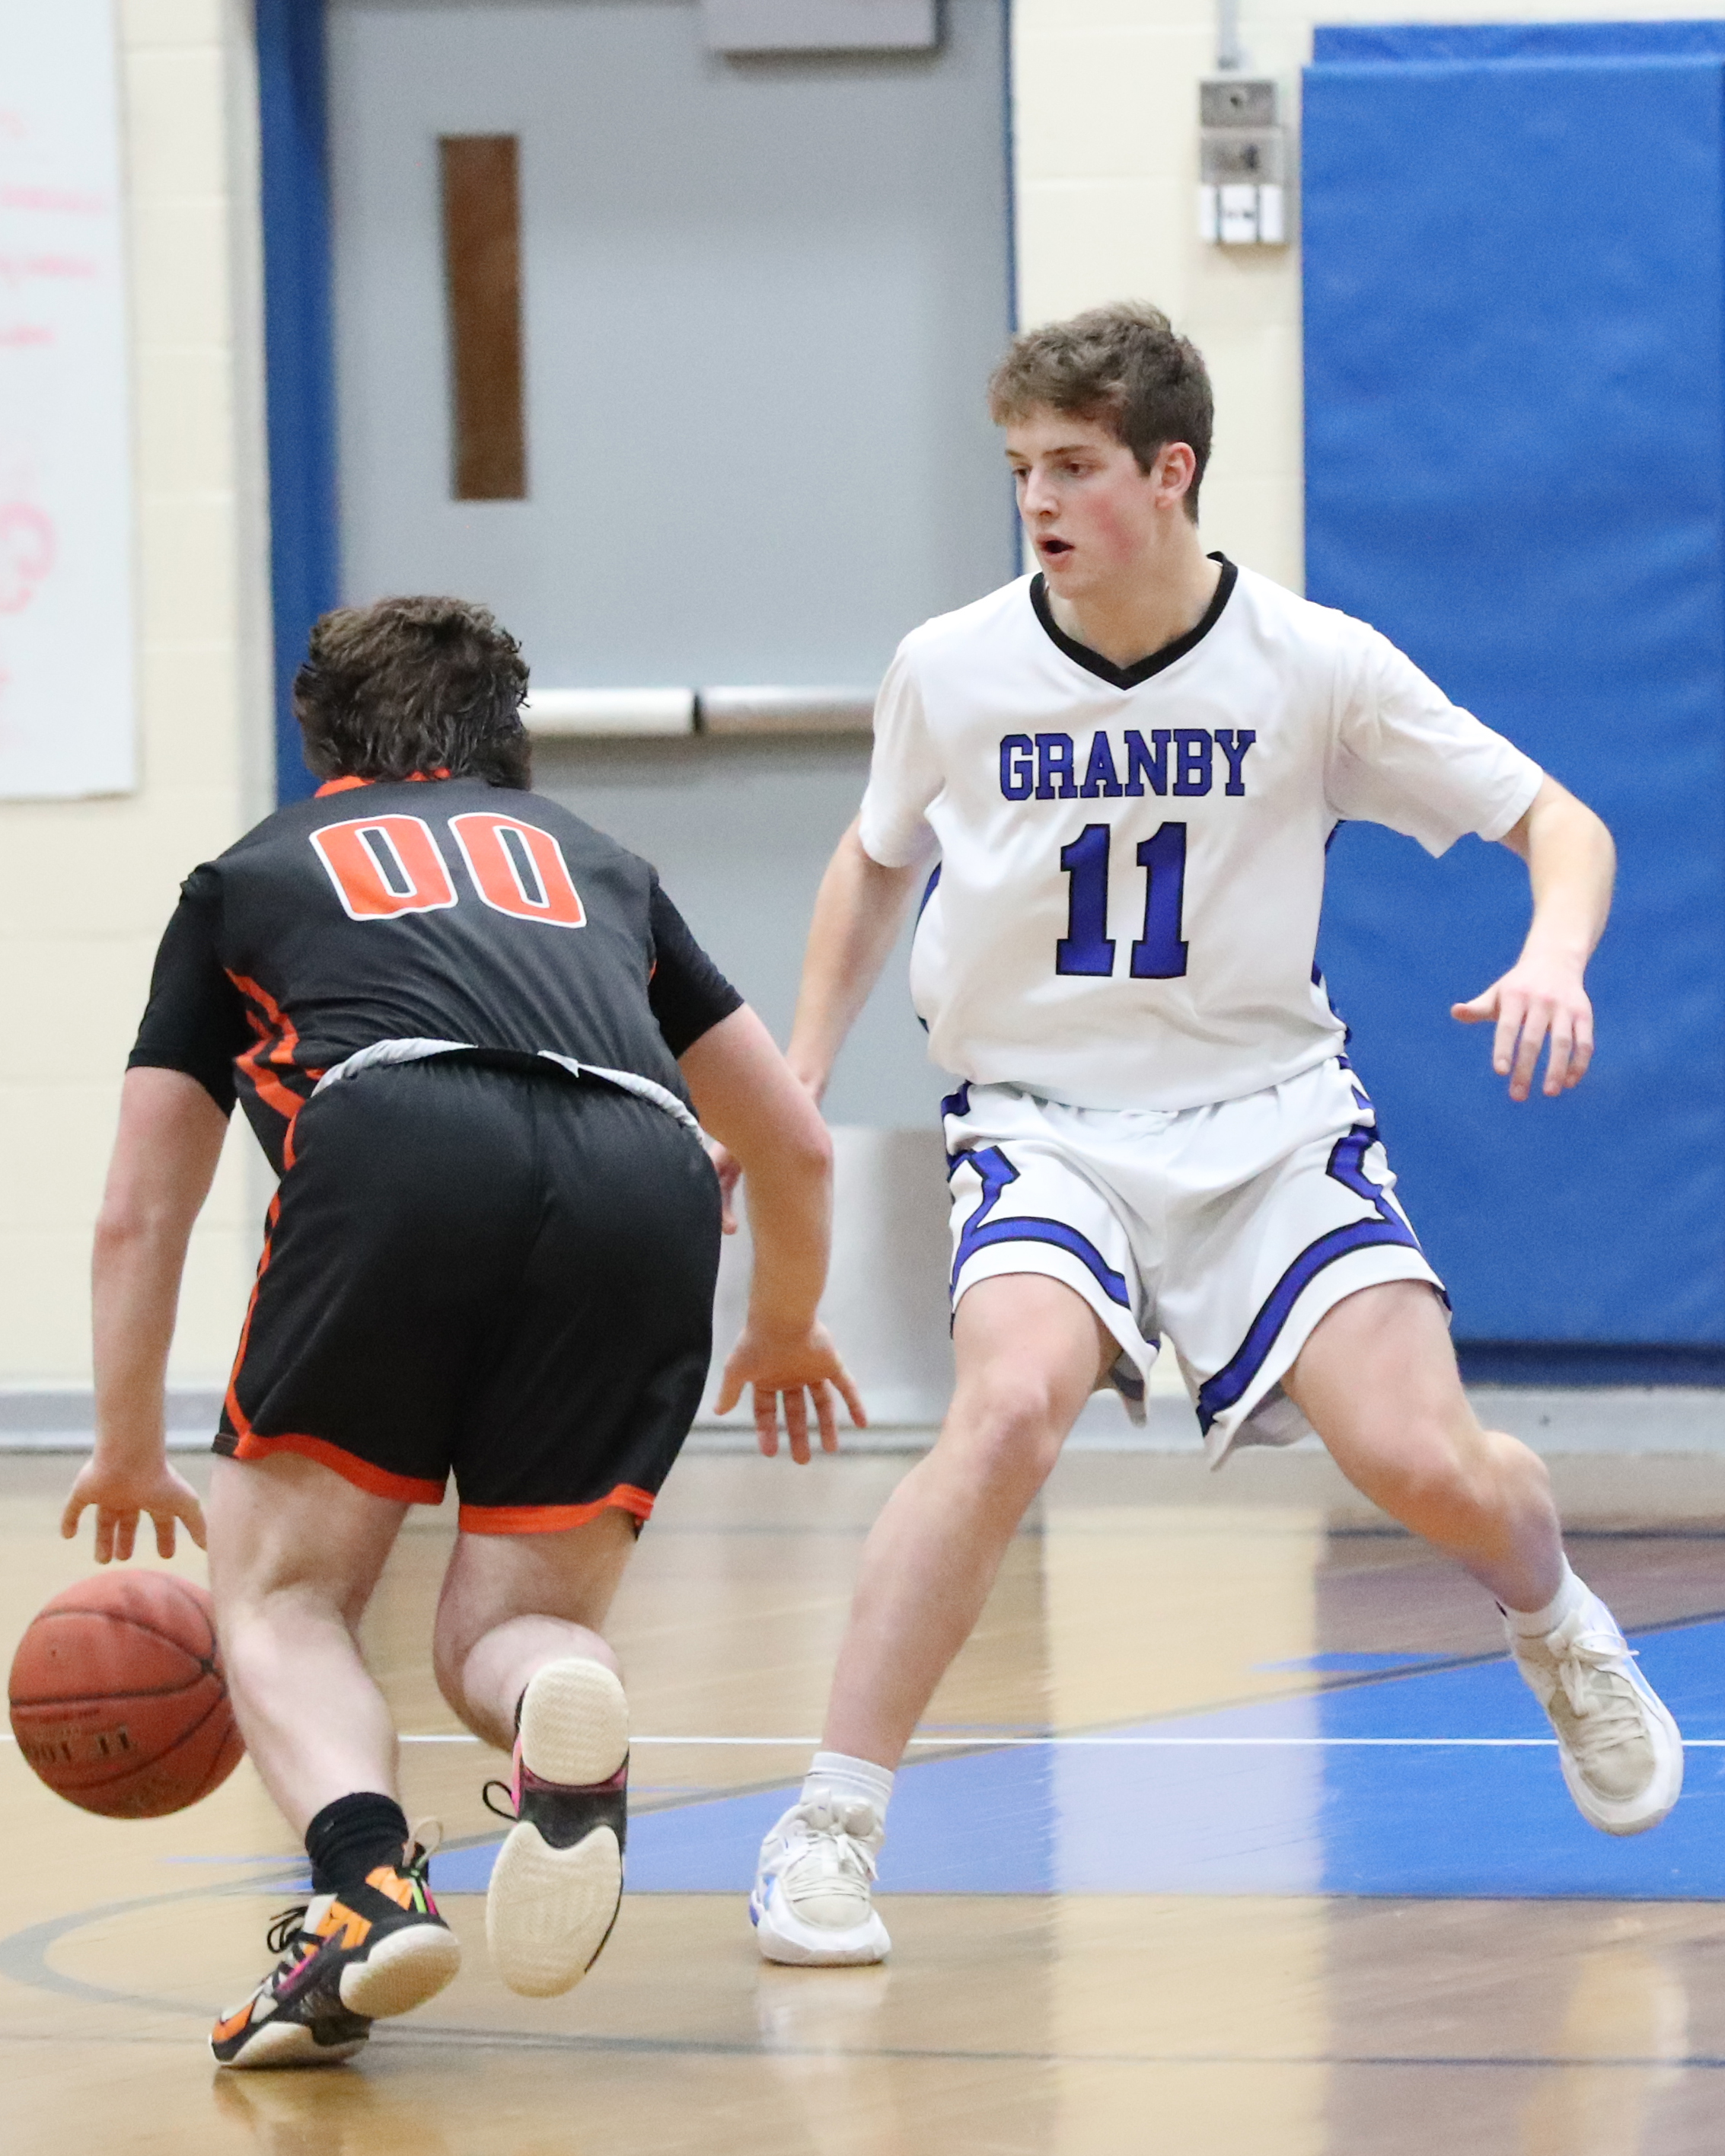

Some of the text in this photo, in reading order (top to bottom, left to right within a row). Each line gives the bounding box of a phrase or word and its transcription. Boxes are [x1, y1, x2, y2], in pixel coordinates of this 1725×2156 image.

[1000, 729, 1256, 801] GRANBY
[308, 812, 587, 929] 00
[1056, 821, 1189, 979] 11
